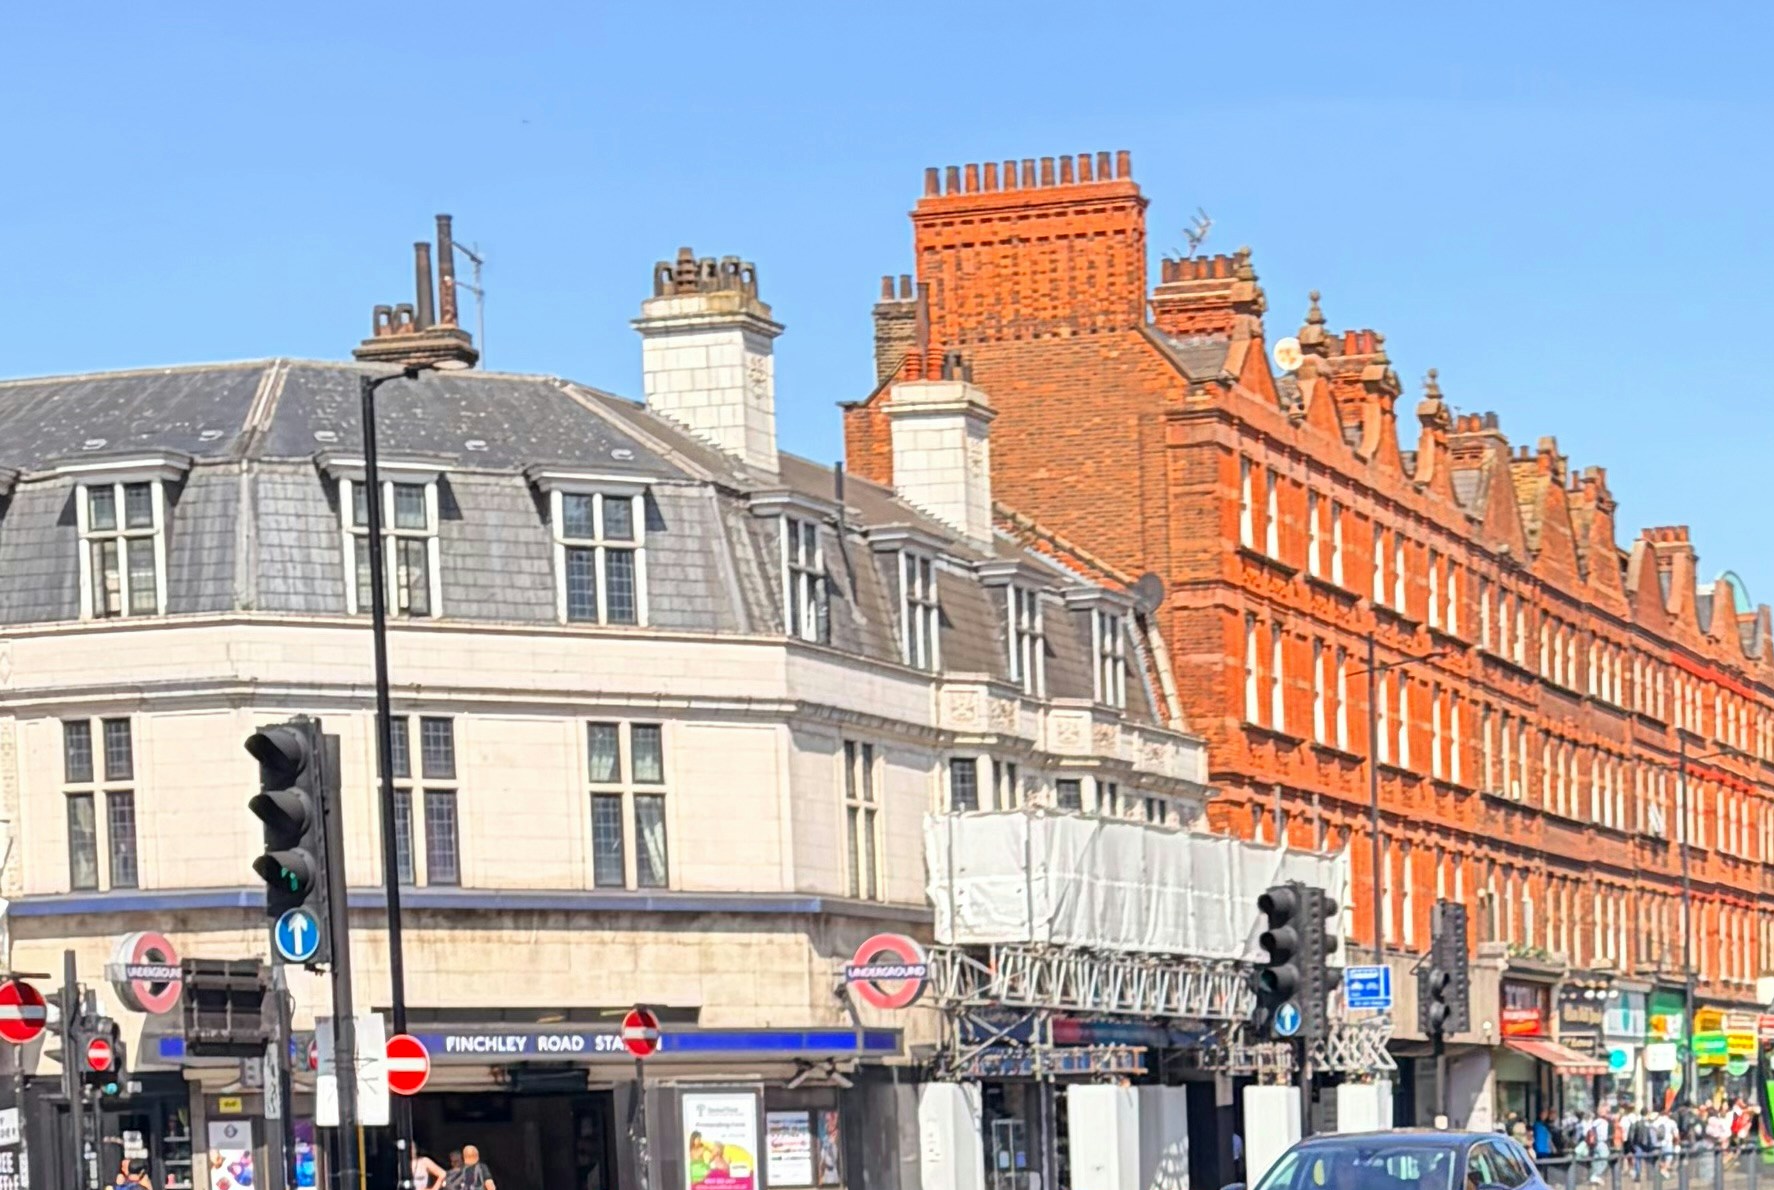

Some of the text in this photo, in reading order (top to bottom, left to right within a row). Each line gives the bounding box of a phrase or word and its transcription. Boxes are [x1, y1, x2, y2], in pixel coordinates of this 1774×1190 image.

[848, 966, 926, 978] UNDERGROUND
[446, 1036, 527, 1052] FINCHLEY
[538, 1035, 585, 1051] ROAD
